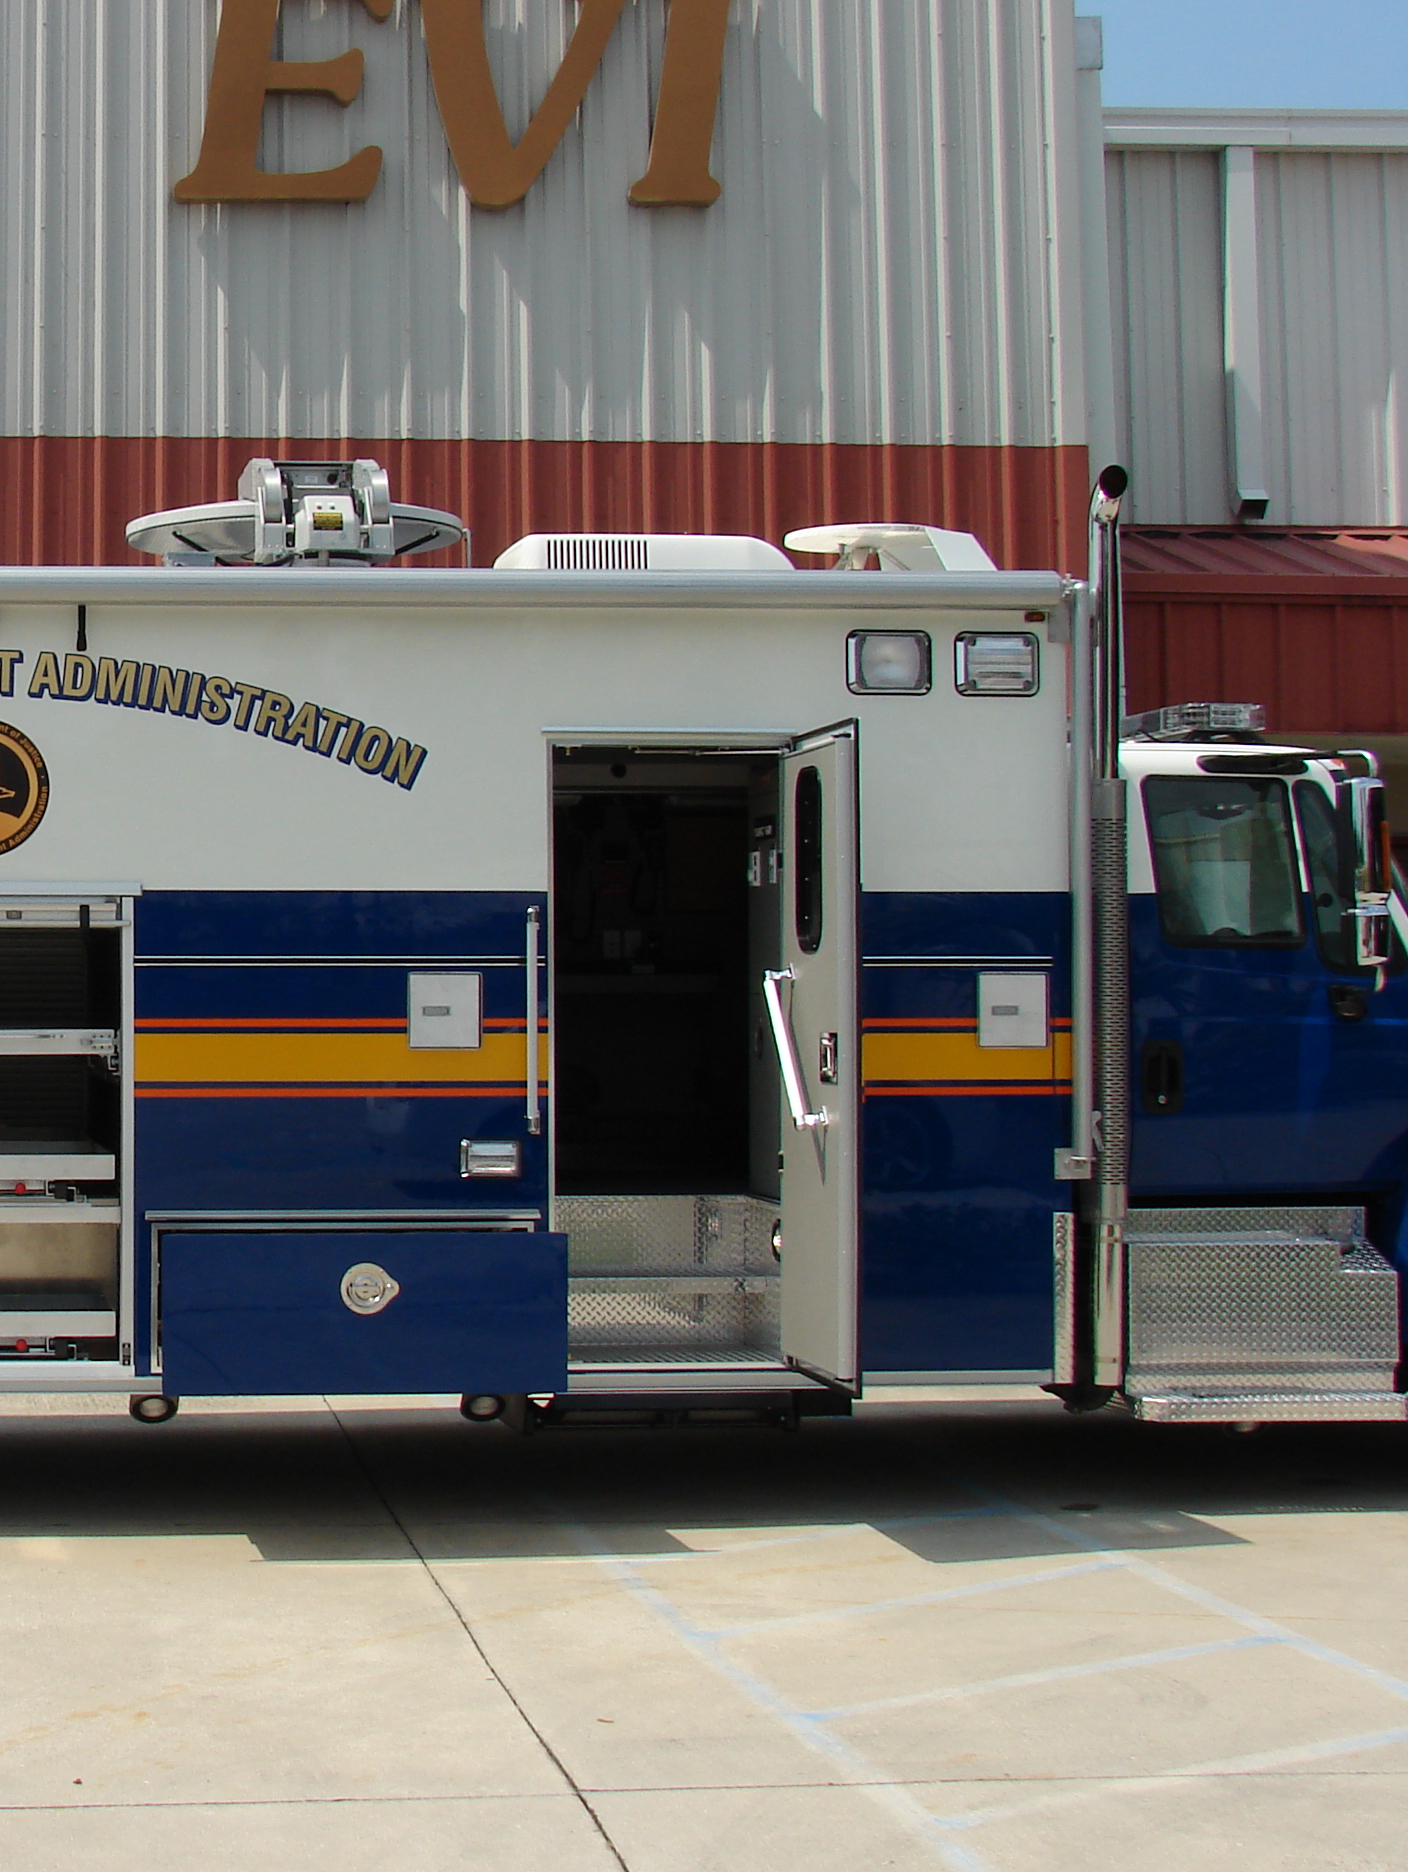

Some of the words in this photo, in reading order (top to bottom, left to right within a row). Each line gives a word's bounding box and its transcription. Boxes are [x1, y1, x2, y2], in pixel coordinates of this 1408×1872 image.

[173, 0, 730, 210] EVI
[10, 728, 21, 739] of
[20, 738, 44, 768] Justice
[28, 651, 429, 791] ADMINISTRATION
[9, 786, 48, 848] Administration
